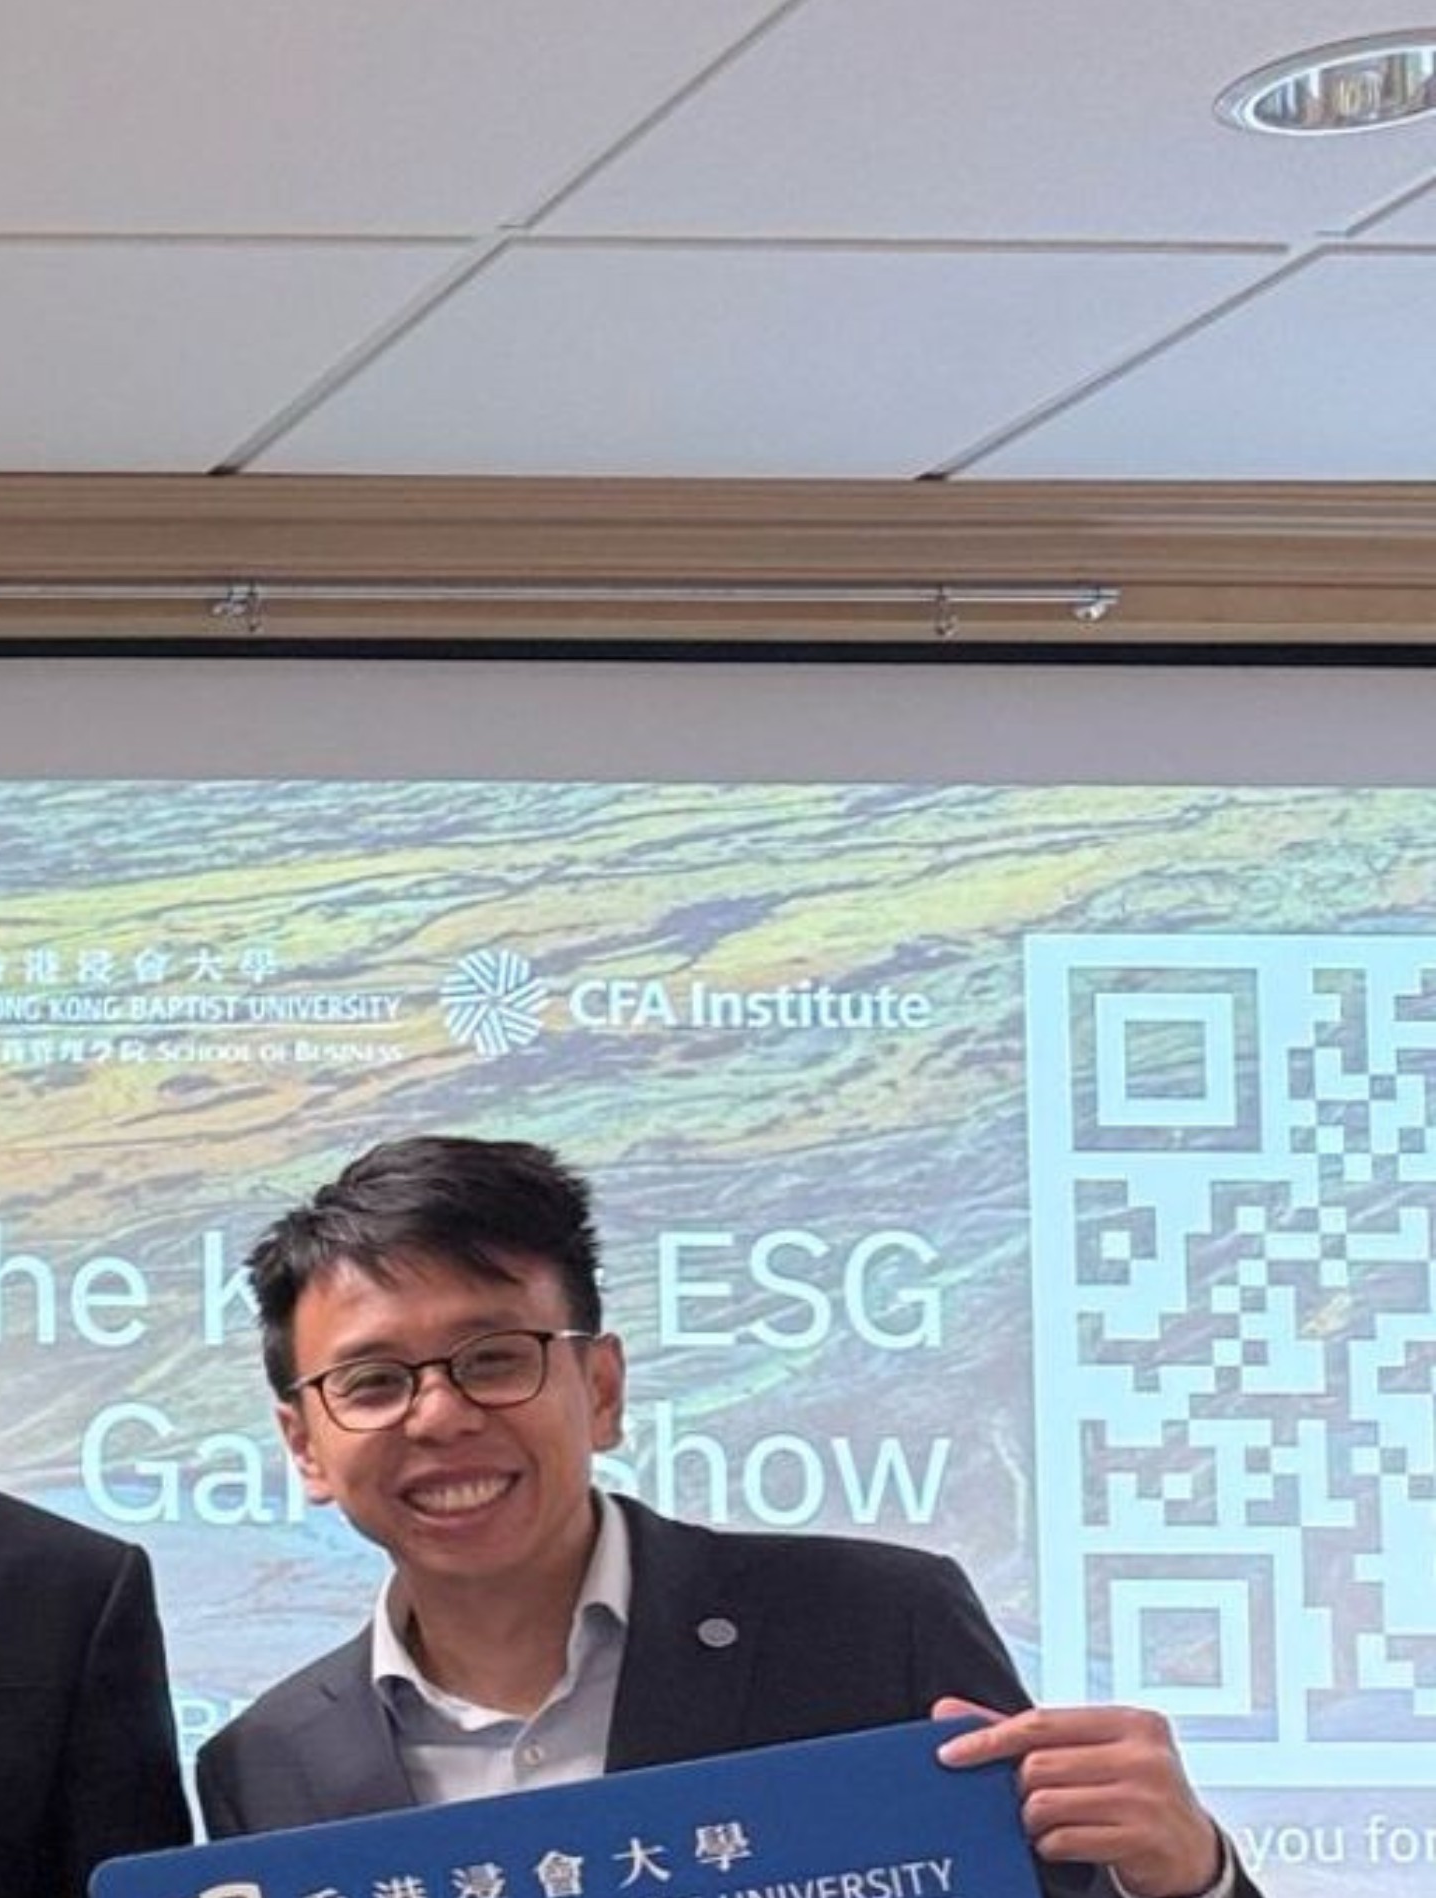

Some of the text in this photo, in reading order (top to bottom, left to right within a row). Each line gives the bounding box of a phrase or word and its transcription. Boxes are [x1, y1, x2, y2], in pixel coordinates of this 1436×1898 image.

[50, 996, 120, 1021] KONG
[132, 996, 237, 1020] BAPTIST
[250, 995, 402, 1020] UNIVERSITY
[569, 978, 932, 1029] CFA Institute
[659, 1229, 944, 1350] ESG
[81, 1402, 306, 1525] Ga
[1243, 1826, 1343, 1873] you
